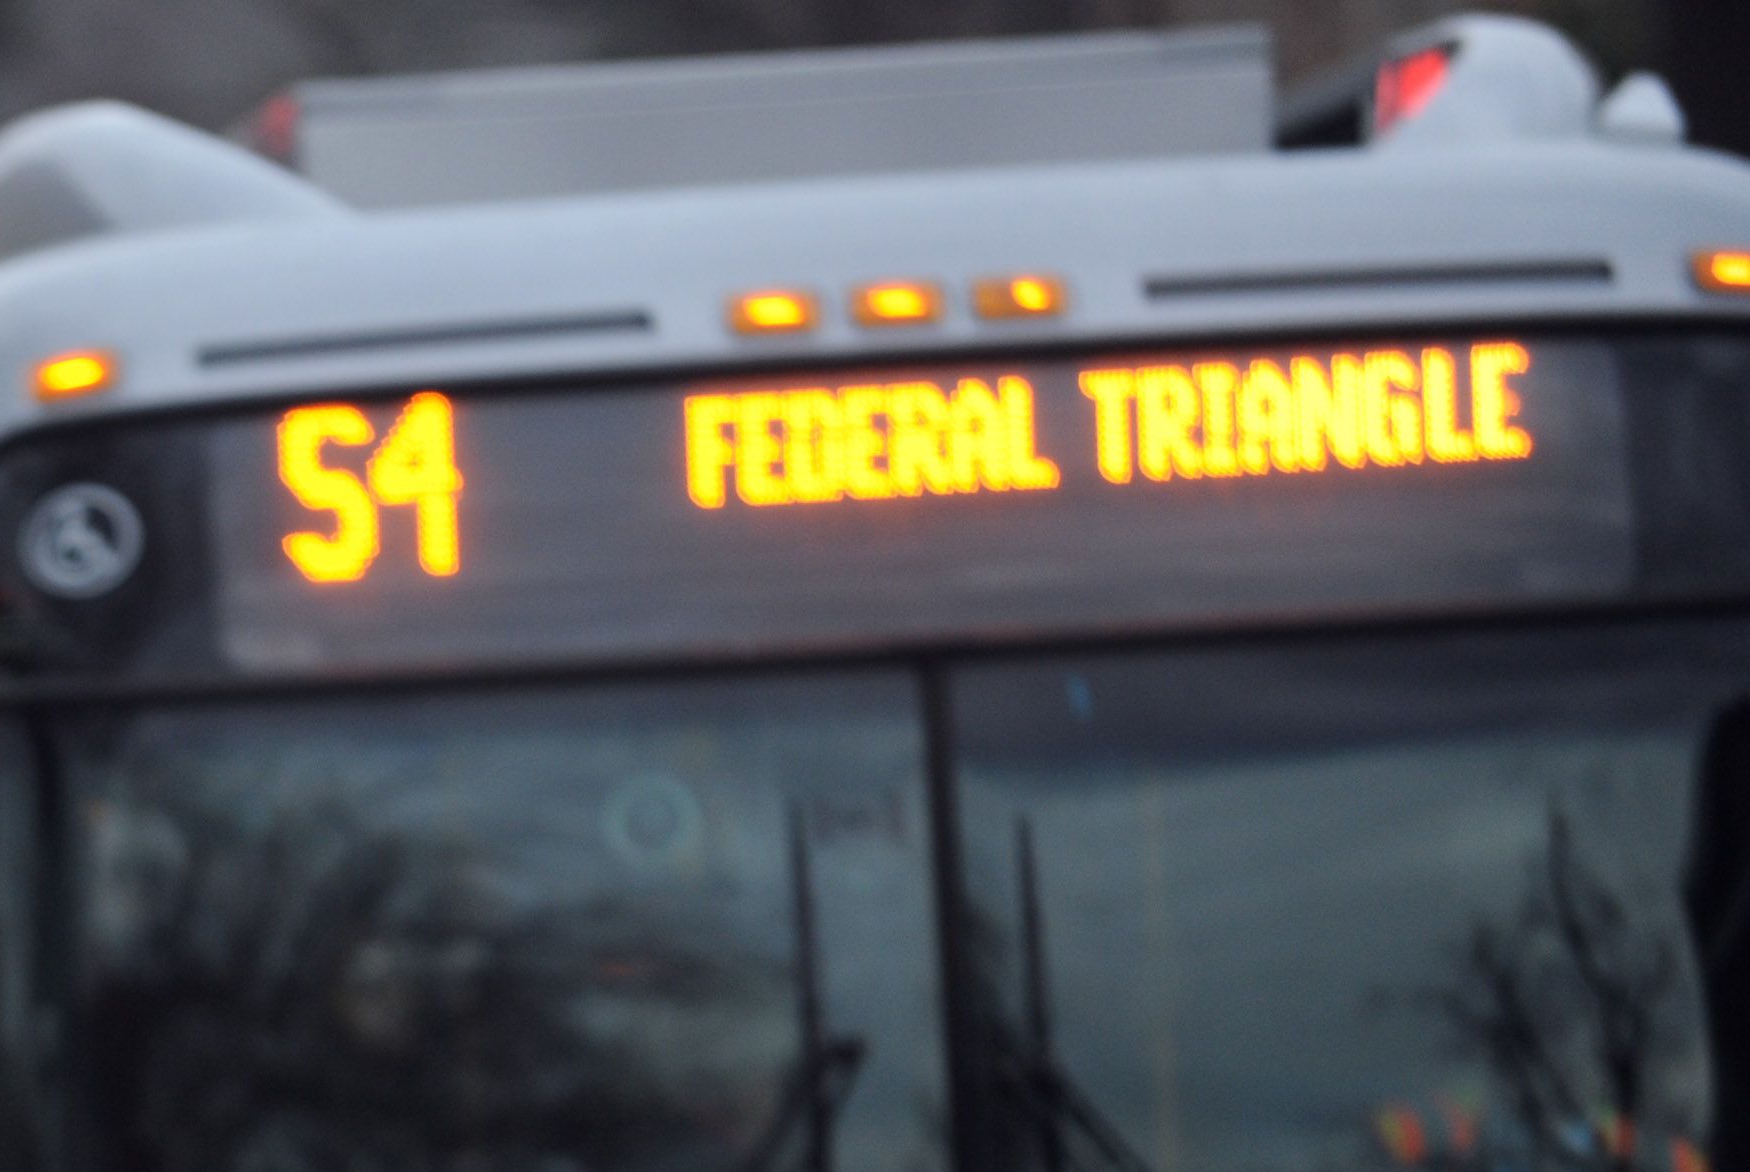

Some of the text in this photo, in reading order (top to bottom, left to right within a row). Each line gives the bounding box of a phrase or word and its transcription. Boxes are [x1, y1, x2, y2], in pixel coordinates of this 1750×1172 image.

[277, 342, 1533, 582] S4 FEDERAL TRIANGLE
